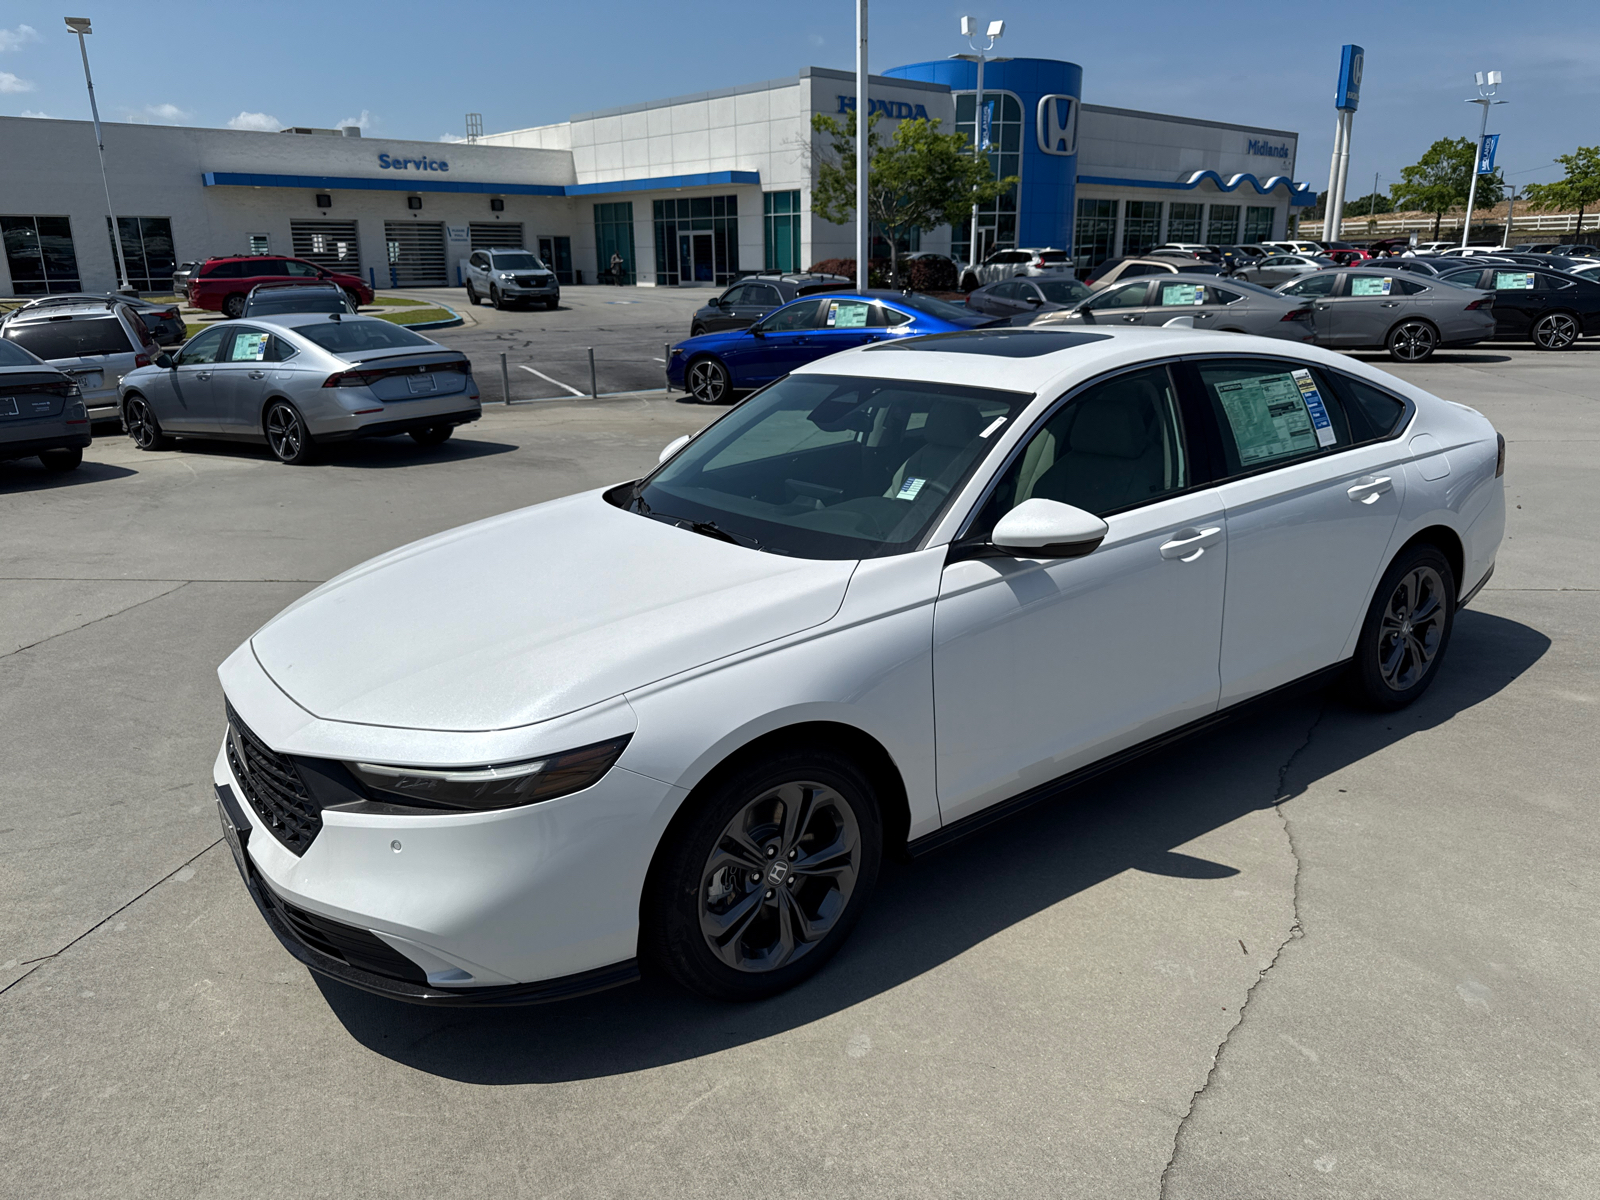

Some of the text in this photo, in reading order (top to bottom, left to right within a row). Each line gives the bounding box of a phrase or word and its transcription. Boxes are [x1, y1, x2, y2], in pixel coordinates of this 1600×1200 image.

[1247, 139, 1289, 158] Midlands
[1481, 137, 1492, 171] MIDLANDS
[378, 153, 449, 172] Service
